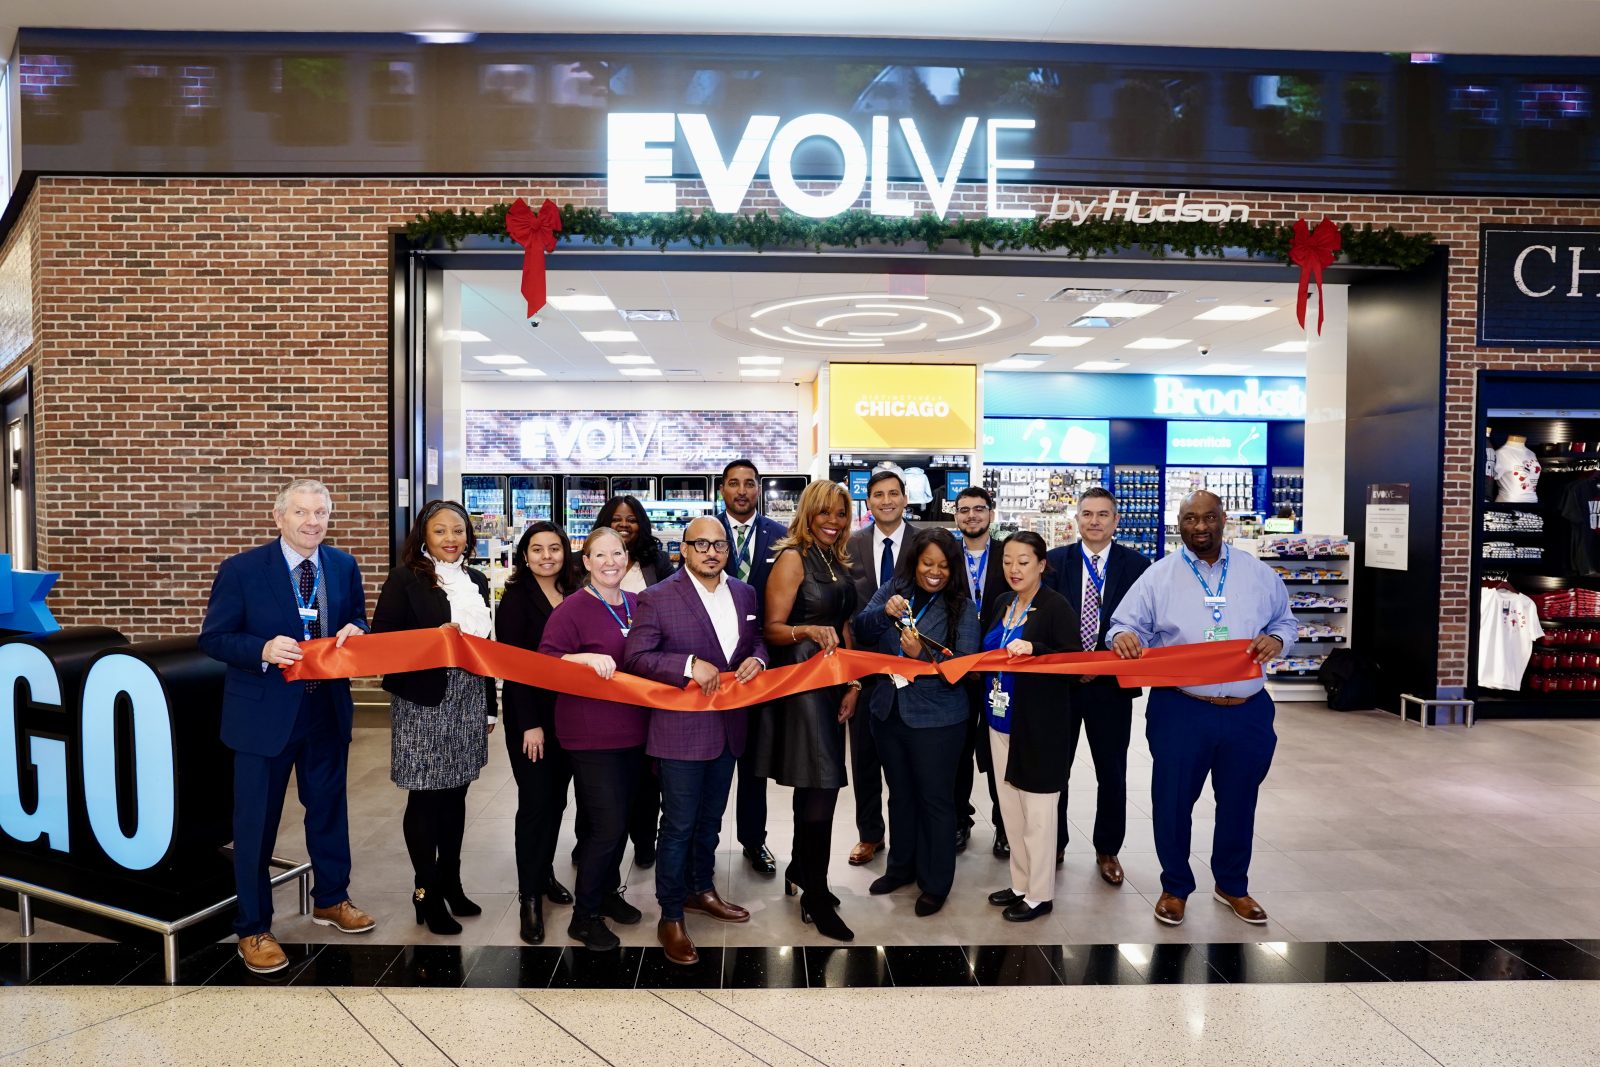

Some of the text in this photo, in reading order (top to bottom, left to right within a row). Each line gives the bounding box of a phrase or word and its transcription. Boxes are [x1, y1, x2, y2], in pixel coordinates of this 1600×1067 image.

[607, 112, 1250, 226] EVOLVE by Hudson
[855, 400, 949, 417] CHICAGO
[1152, 376, 1306, 416] Brookst
[519, 419, 677, 461] EVOLVE
[1171, 435, 1232, 448] essentials
[0, 642, 175, 871] GO
